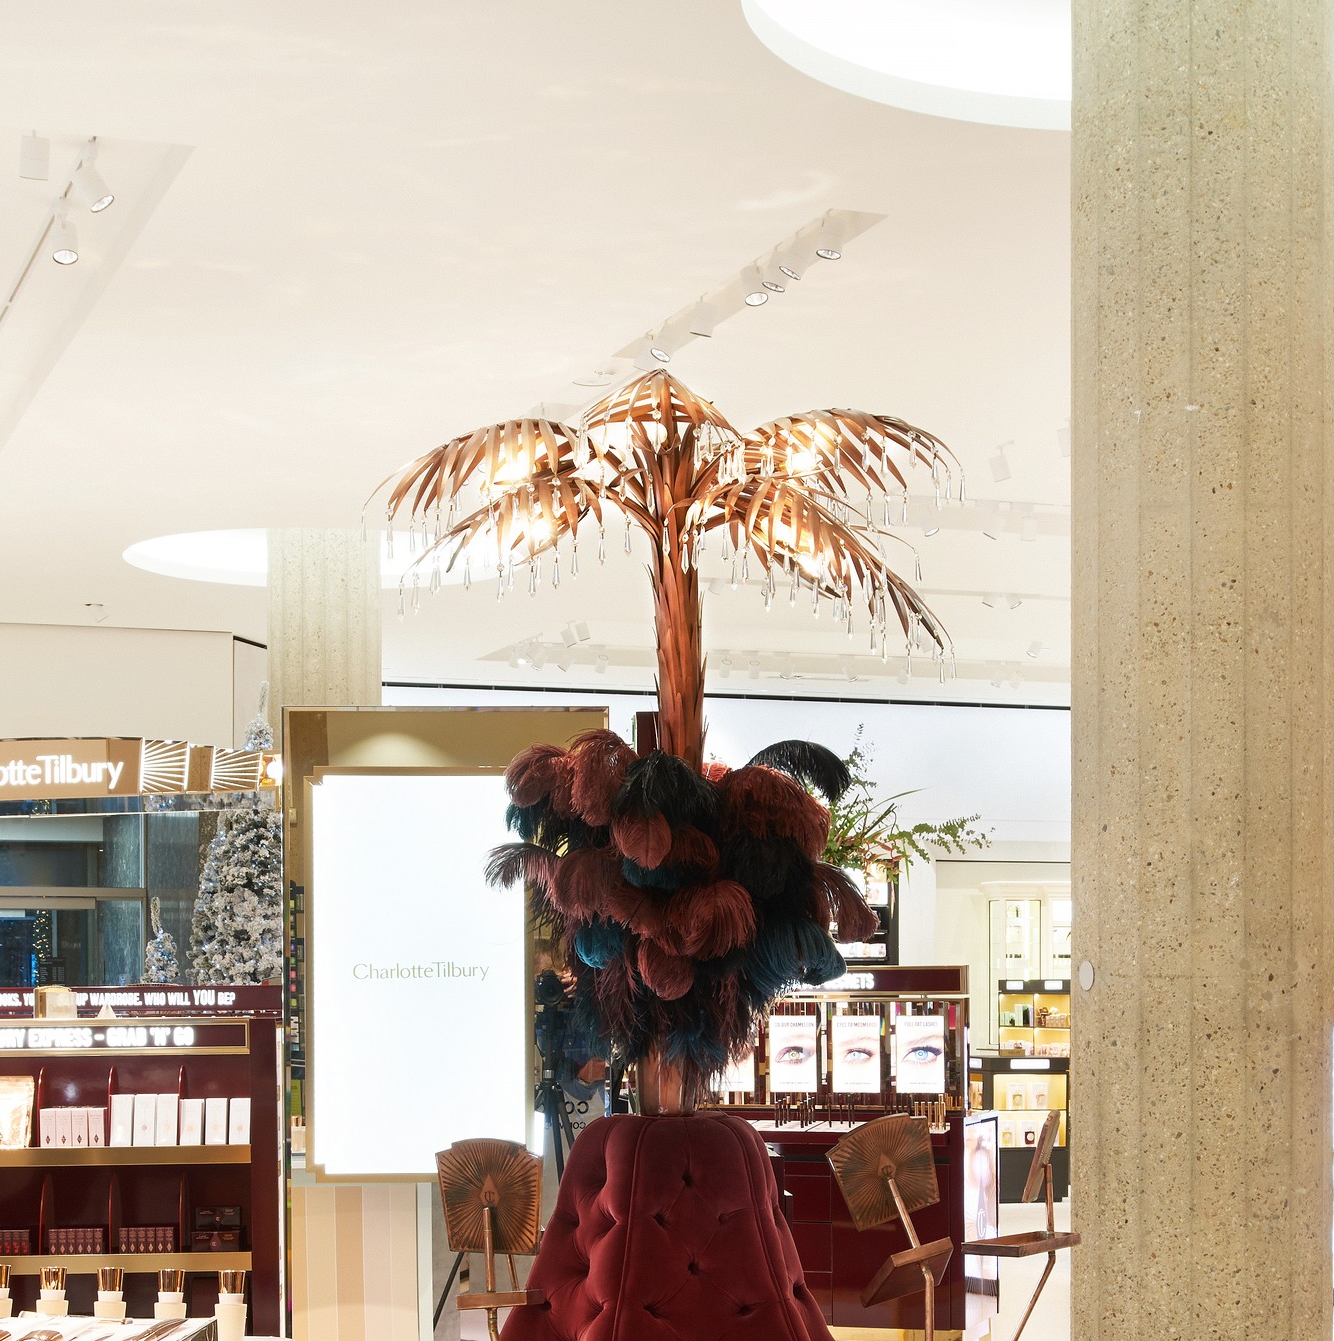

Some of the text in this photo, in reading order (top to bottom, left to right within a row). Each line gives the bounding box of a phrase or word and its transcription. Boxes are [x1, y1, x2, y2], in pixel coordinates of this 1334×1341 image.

[352, 961, 490, 981] CharlotteTilbury
[144, 992, 166, 1006] WHO
[167, 992, 191, 1006] WILL
[193, 989, 215, 1006] YOU
[27, 1027, 93, 1048] EXPRESS
[173, 1026, 195, 1047] GO
